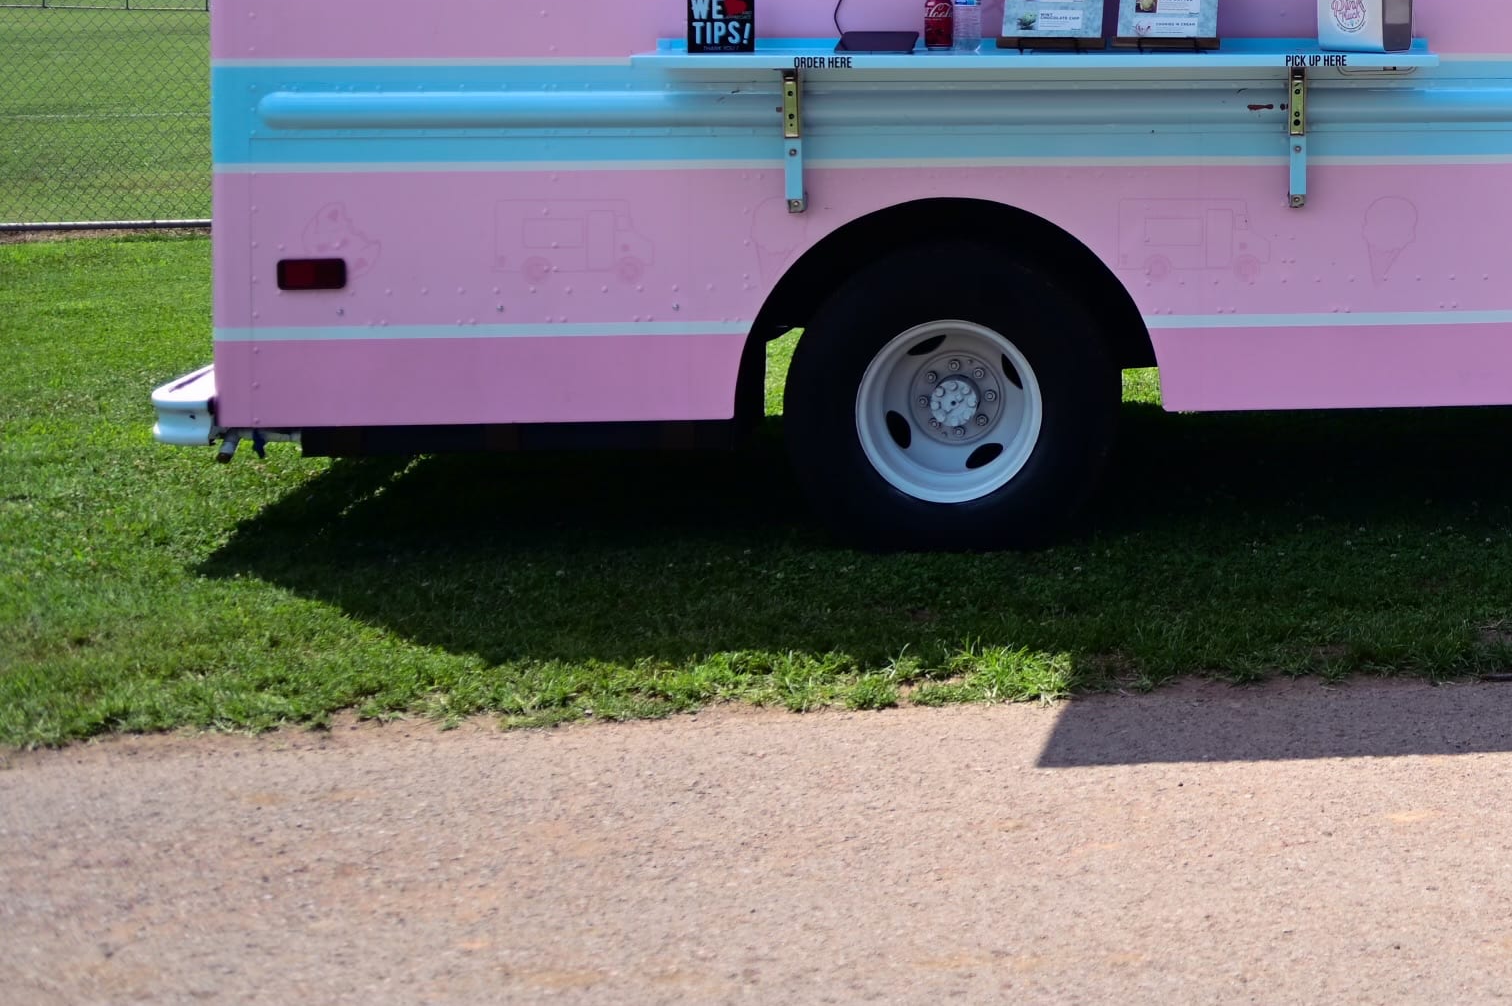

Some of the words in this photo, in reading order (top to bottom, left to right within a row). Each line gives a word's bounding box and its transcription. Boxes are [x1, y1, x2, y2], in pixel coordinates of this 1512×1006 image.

[692, 21, 751, 44] TIPS!
[794, 56, 825, 69] ORDER
[828, 56, 852, 69] HERE
[1286, 55, 1306, 66] PICK
[1309, 55, 1322, 66] UP
[1324, 55, 1347, 66] HERE
